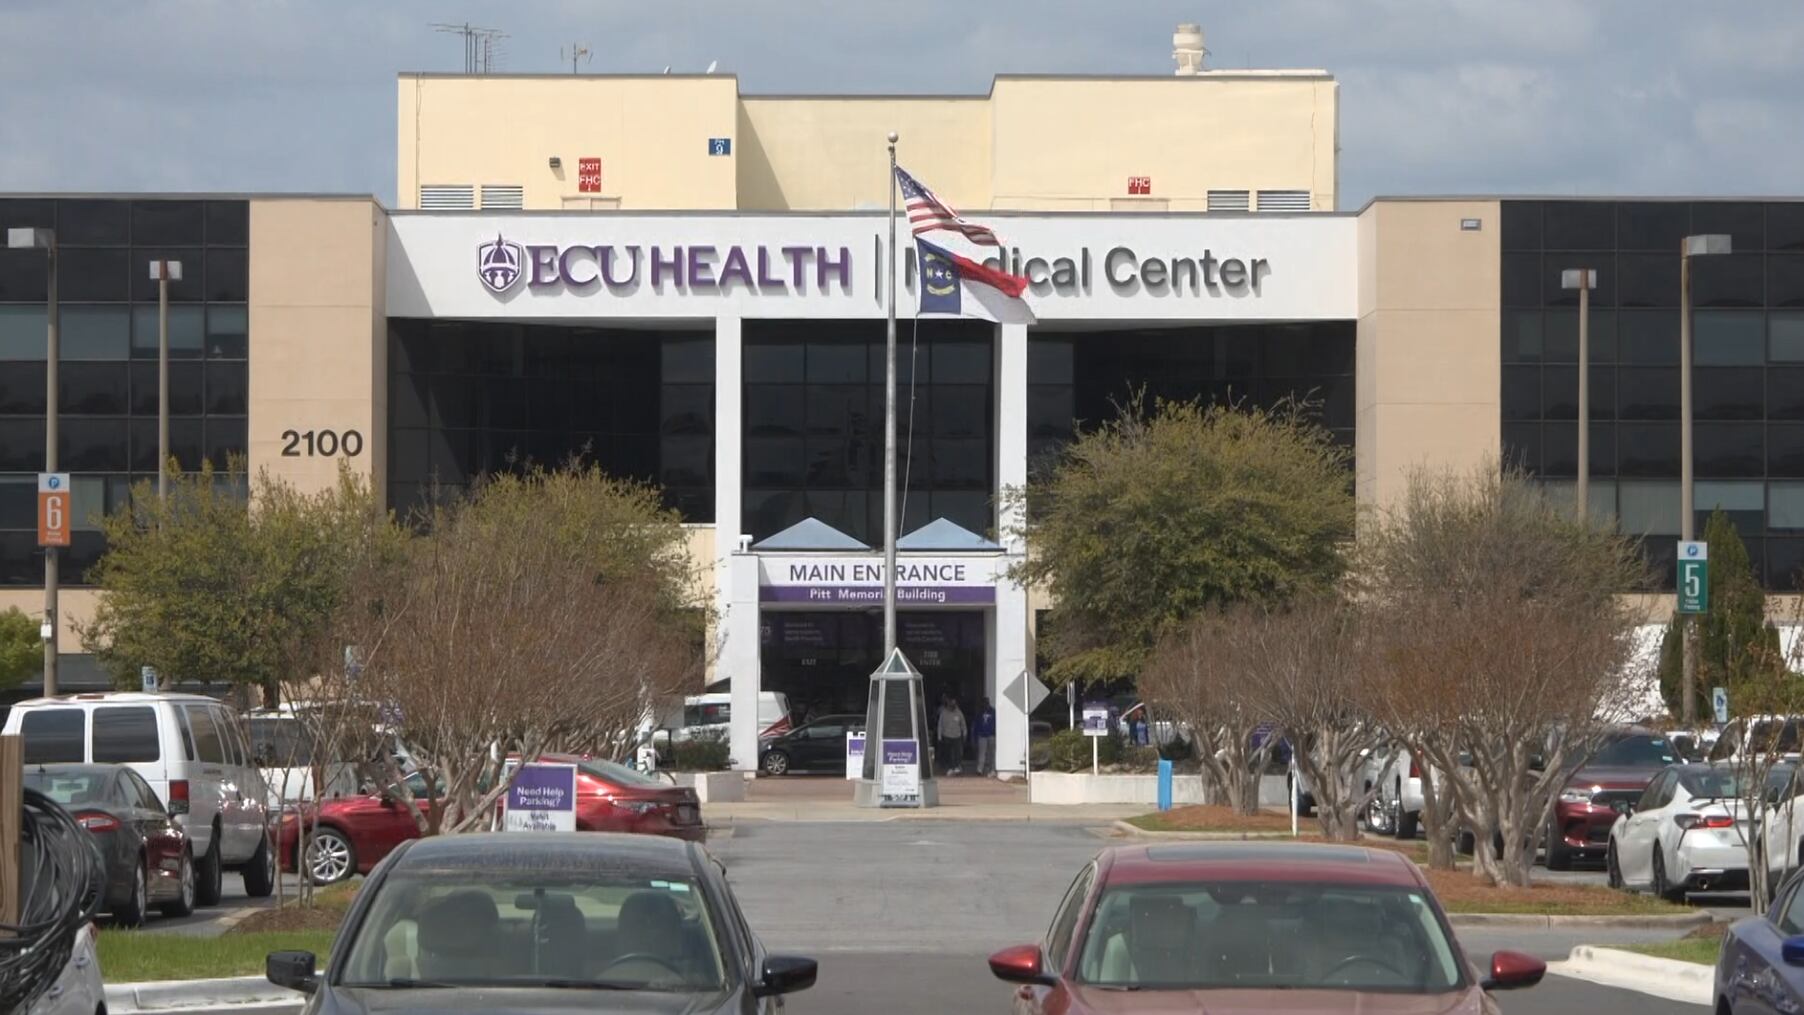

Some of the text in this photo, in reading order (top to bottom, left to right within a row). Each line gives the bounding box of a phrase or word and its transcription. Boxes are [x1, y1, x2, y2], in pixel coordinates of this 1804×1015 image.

[580, 175, 600, 185] FHC
[526, 245, 641, 287] ECU
[651, 246, 848, 287] HEALTH
[1105, 246, 1267, 288] Center
[281, 429, 363, 456] 2100
[47, 497, 61, 529] 6
[790, 565, 965, 581] MAIN ENRANCE
[1685, 564, 1699, 596] 5
[810, 589, 946, 602] Pitt Memori Building
[517, 787, 564, 797] Need Help
[520, 797, 560, 807] Parking?
